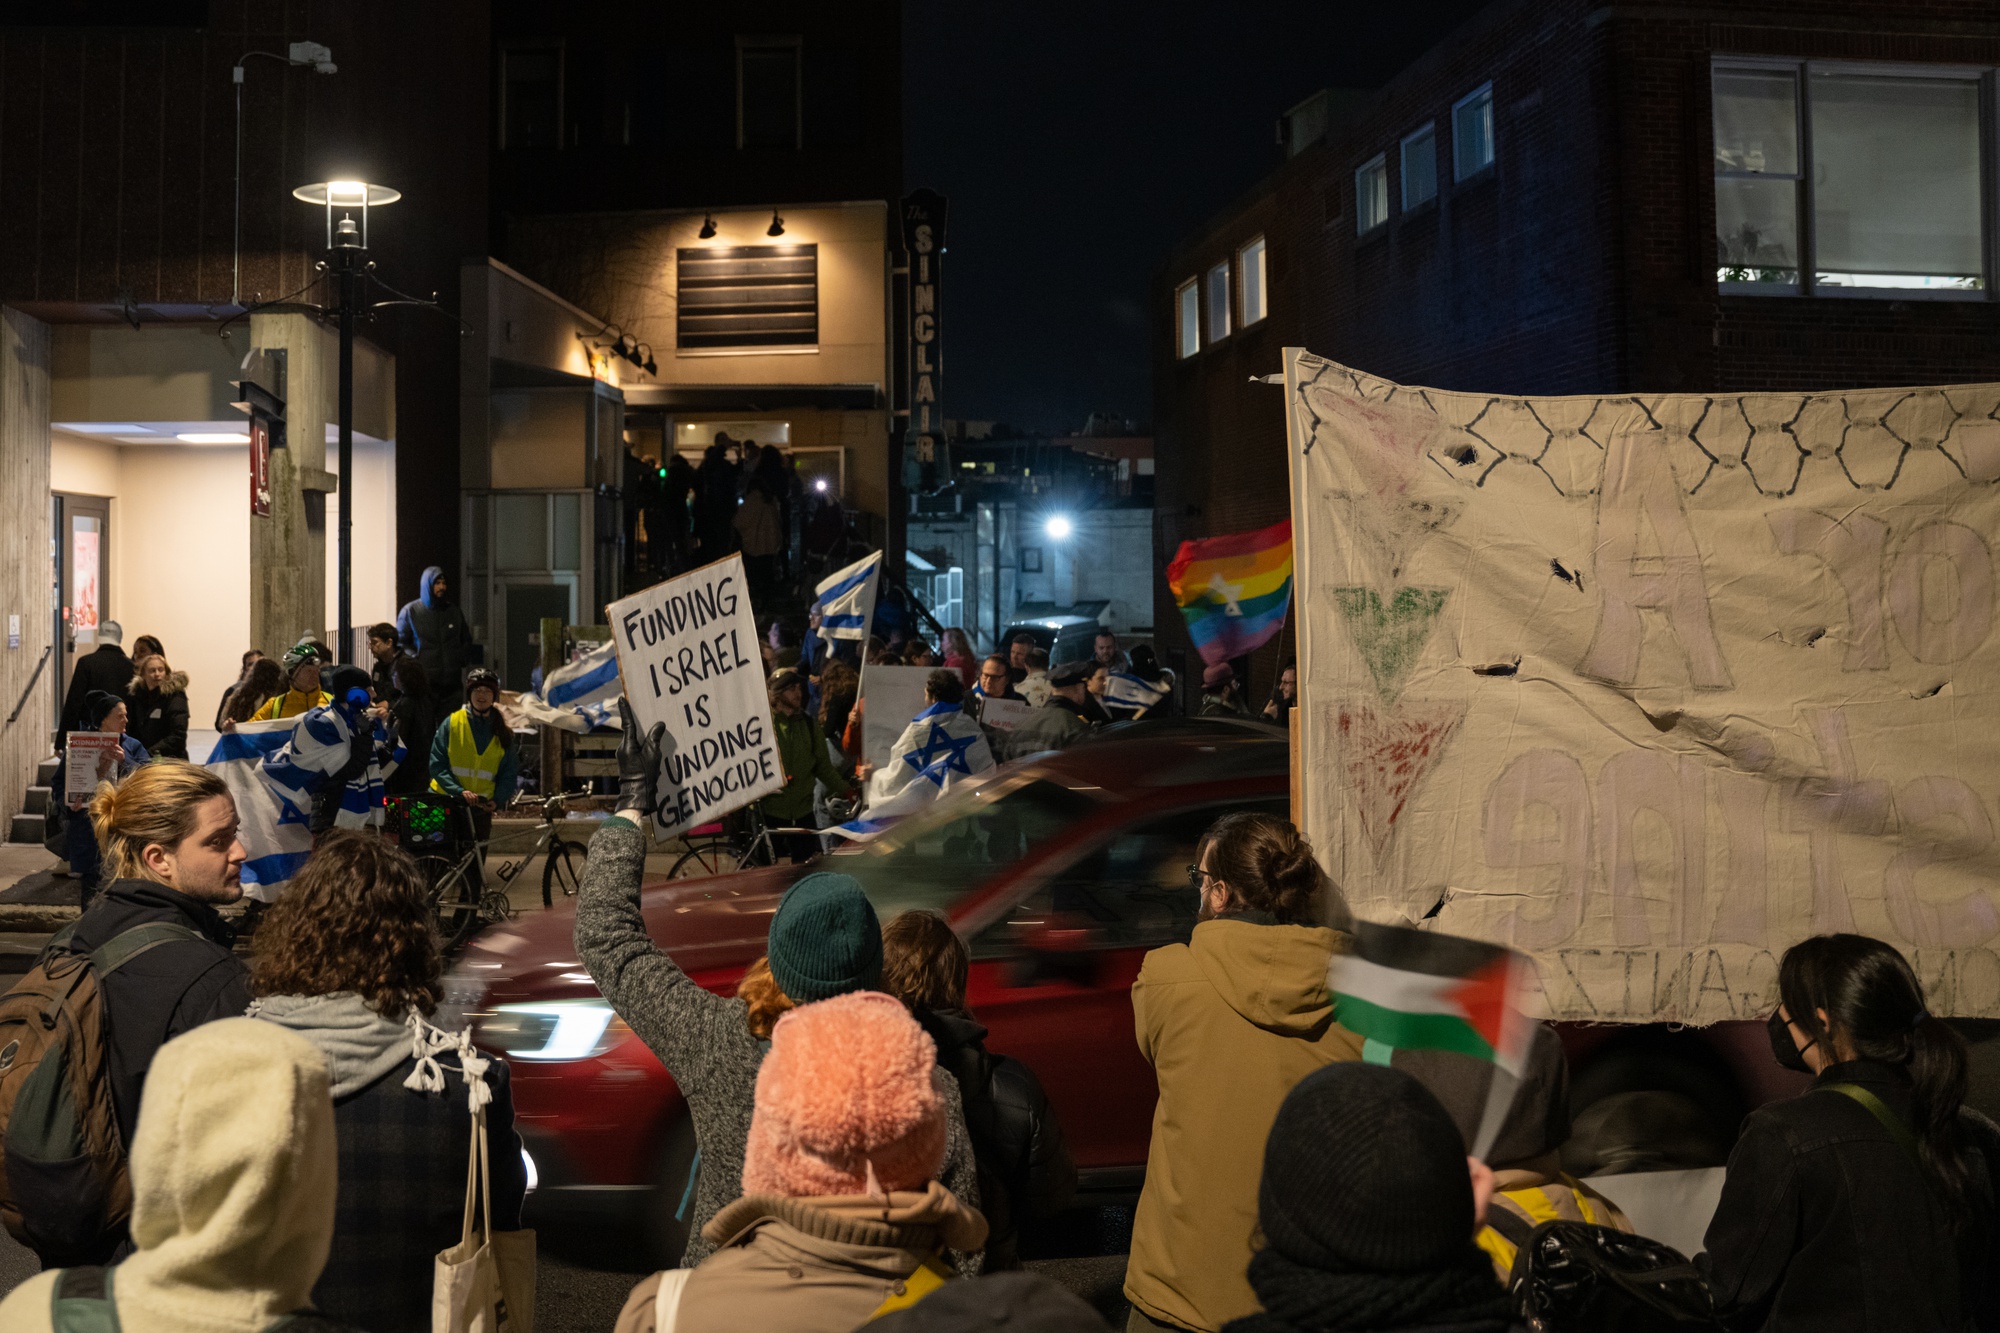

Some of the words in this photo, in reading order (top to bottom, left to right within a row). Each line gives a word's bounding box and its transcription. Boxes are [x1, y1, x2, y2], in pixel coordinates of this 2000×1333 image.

[907, 204, 928, 220] The
[914, 224, 935, 462] SINCLAIR
[623, 576, 738, 651] FUNDING
[649, 628, 750, 698] ISRAEL
[683, 694, 712, 729] IS
[662, 716, 763, 786] UNDING
[656, 747, 776, 830] GENOCIDE
